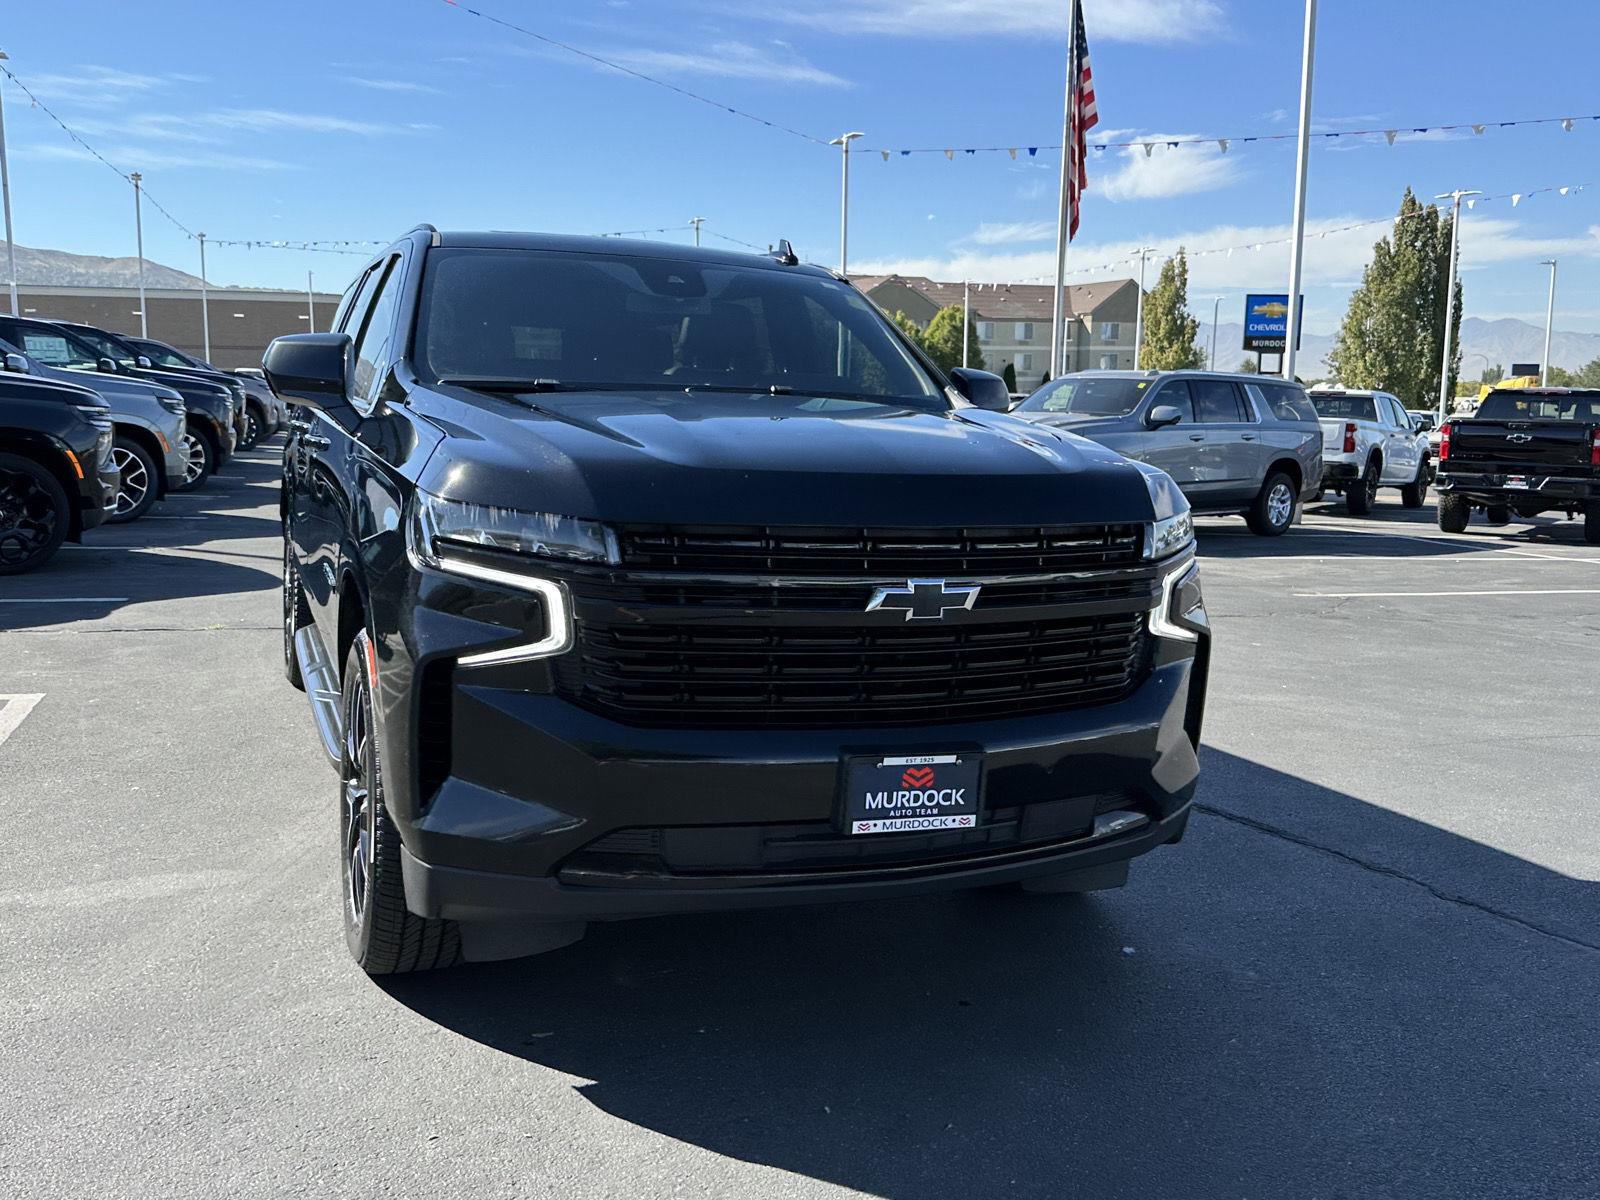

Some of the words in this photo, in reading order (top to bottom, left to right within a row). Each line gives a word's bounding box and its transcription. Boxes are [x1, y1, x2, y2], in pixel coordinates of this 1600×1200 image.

[1249, 323, 1286, 331] CHEVROL
[865, 789, 966, 809] MURDOCK
[916, 808, 939, 816] TEAM
[882, 818, 949, 831] MURDOCK
